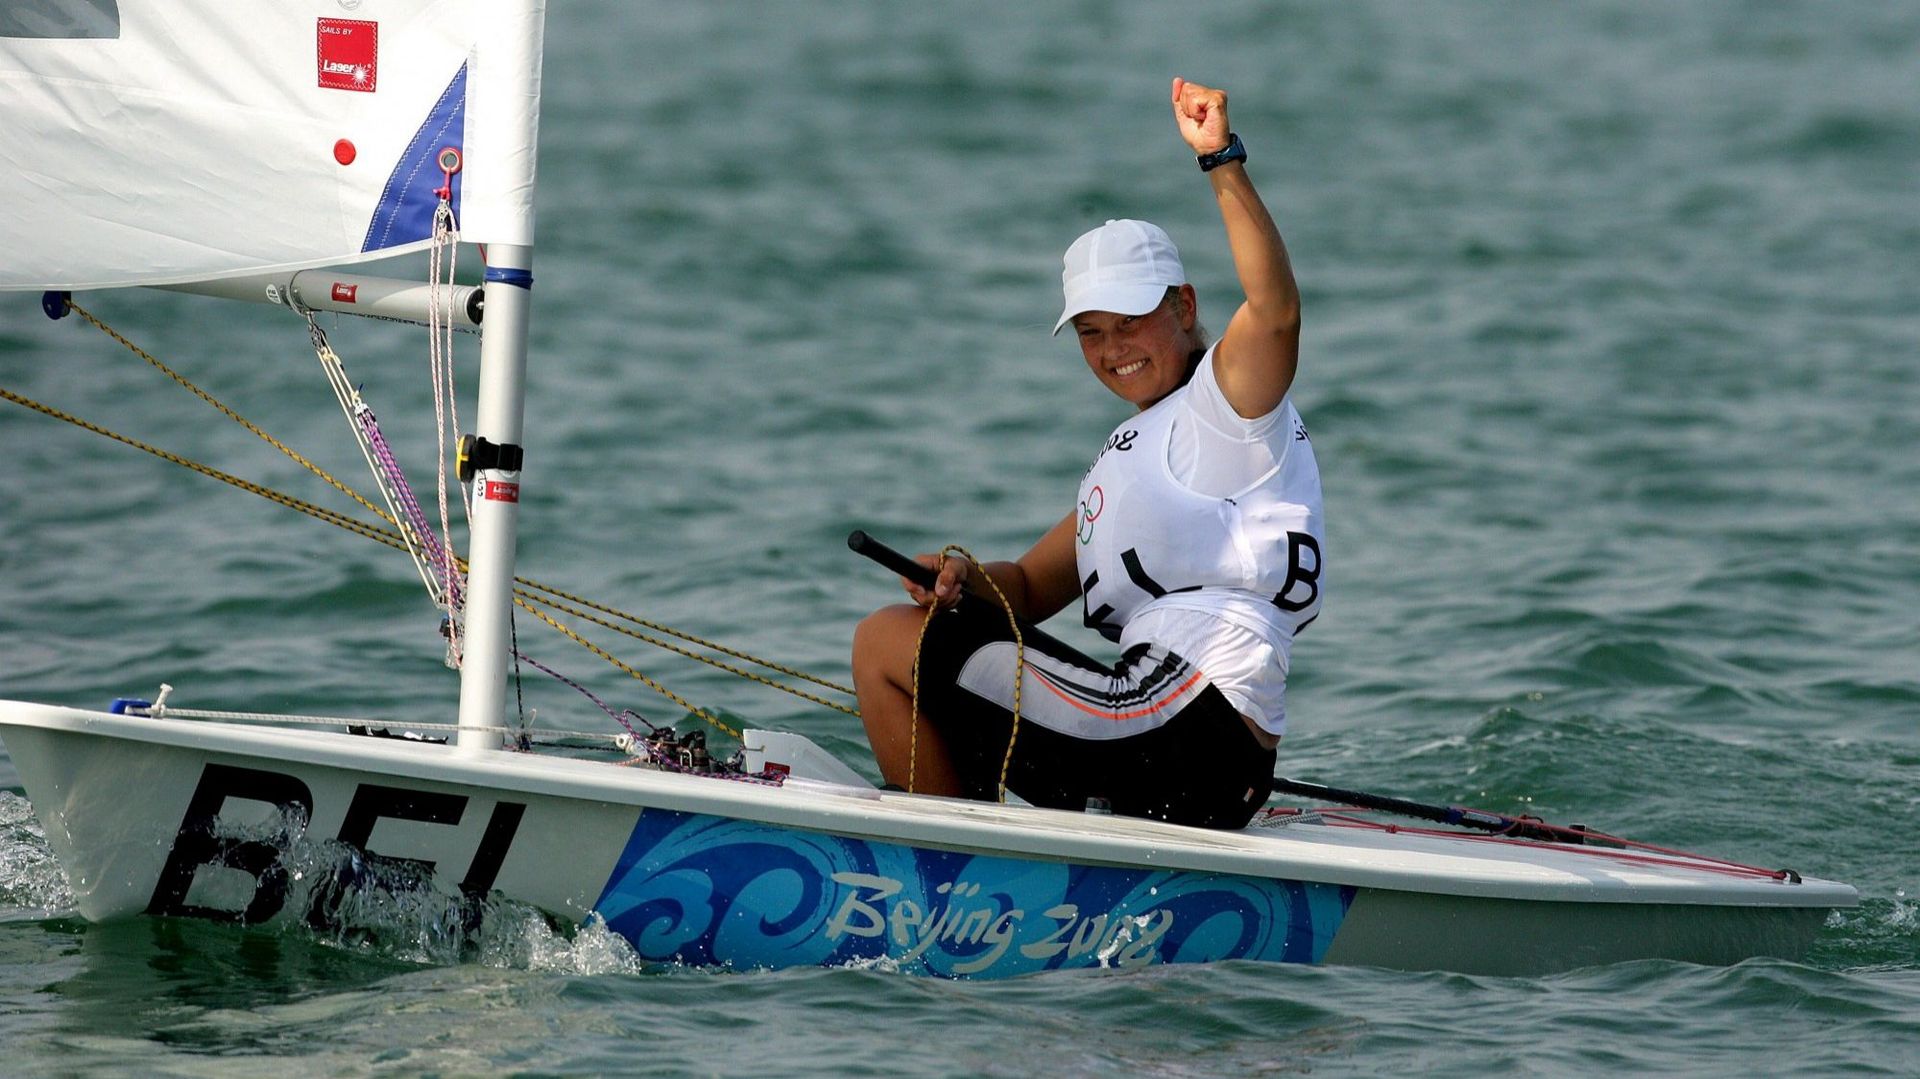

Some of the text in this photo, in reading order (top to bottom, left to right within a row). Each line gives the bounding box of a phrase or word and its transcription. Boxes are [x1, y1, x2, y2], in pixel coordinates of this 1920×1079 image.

[321, 26, 341, 35] SAILS
[323, 60, 354, 72] Laser
[825, 872, 1174, 973] Beijing 2008
